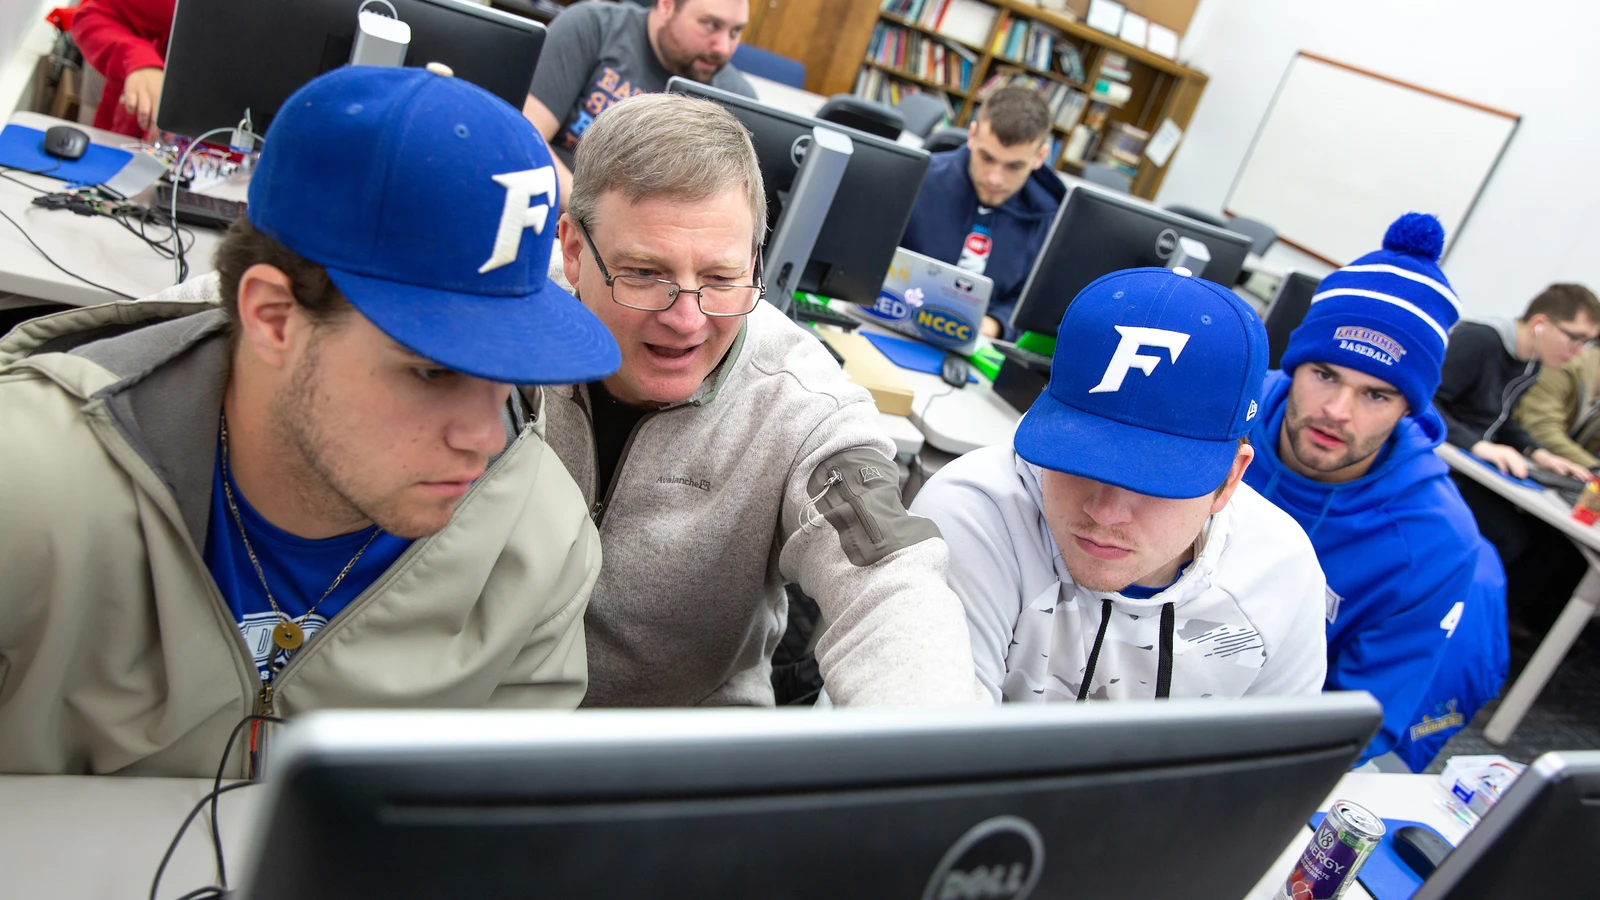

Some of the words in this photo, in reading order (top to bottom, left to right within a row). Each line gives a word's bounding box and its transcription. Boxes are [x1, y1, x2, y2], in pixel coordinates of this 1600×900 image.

[478, 165, 557, 274] F
[918, 311, 970, 340] NCCC
[1088, 324, 1191, 394] F
[1339, 340, 1393, 365] BASEBALL
[656, 475, 700, 488] Avalanche
[1319, 825, 1334, 849] V8
